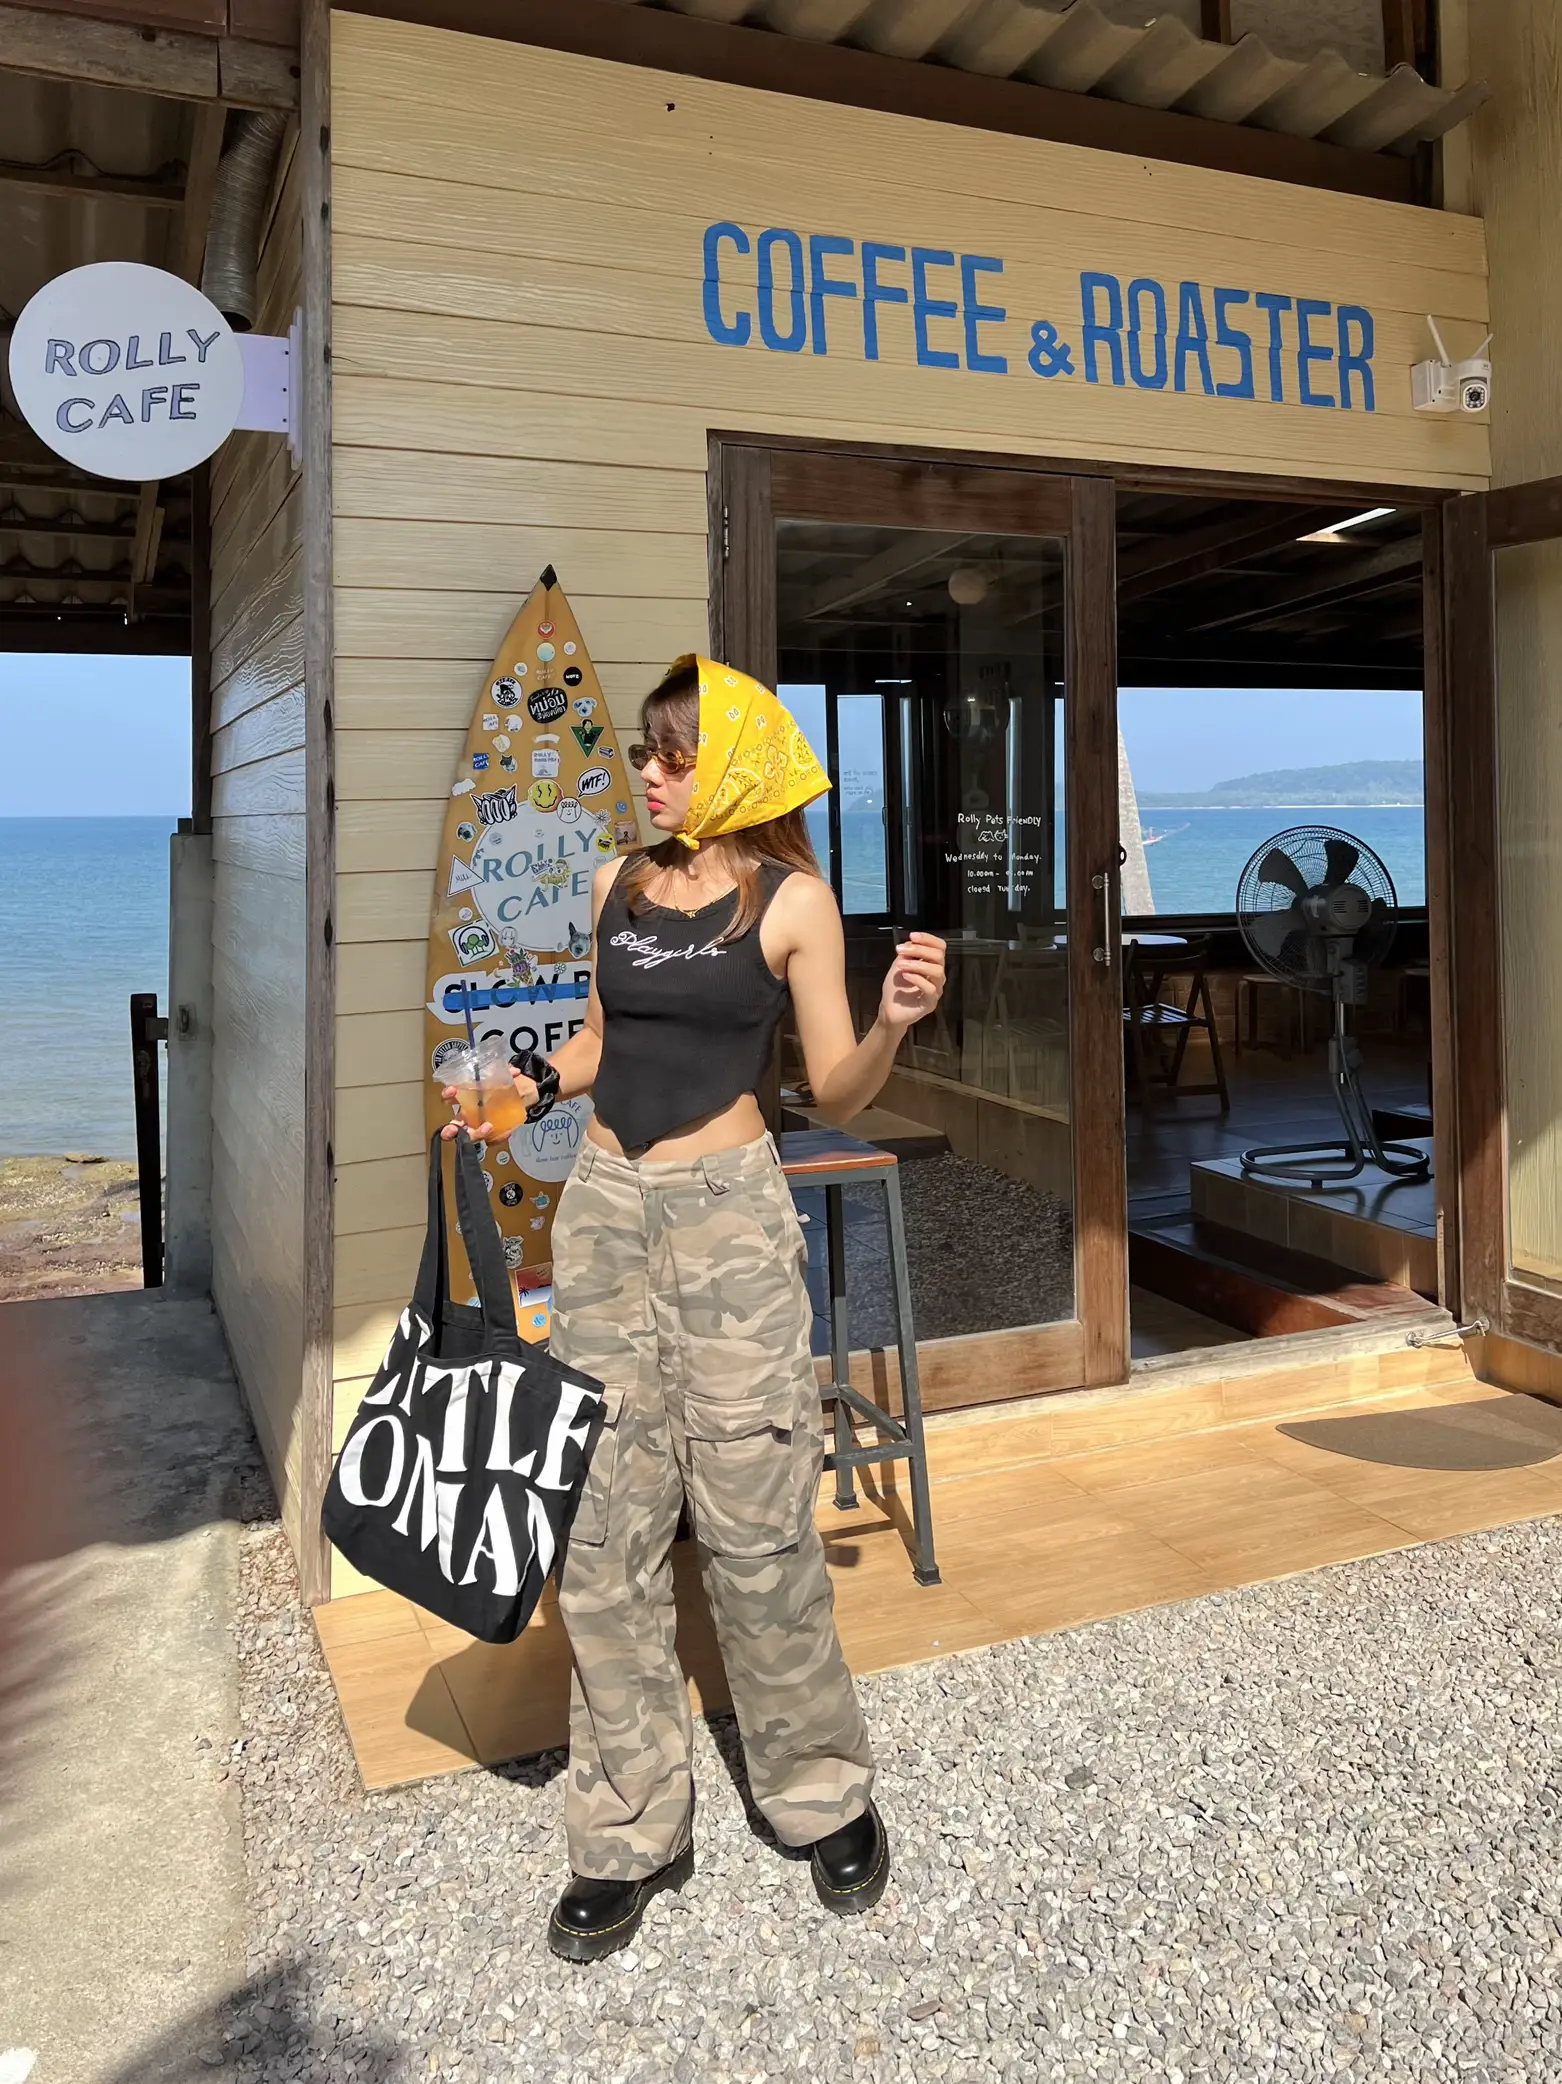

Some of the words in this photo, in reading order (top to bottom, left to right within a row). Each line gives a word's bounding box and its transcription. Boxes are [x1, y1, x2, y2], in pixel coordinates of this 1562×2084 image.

[703, 222, 1008, 374] COFFEE
[1028, 319, 1076, 378] &
[1080, 271, 1376, 412] ROASTER
[45, 328, 220, 377] ROLLY
[56, 382, 201, 434] CAFE
[581, 772, 606, 791] WTF!
[957, 812, 981, 830] Rolly
[985, 814, 1004, 825] Pets
[484, 828, 597, 882] ROLLY
[993, 852, 1003, 861] to
[339, 1415, 556, 1597] OMAN
